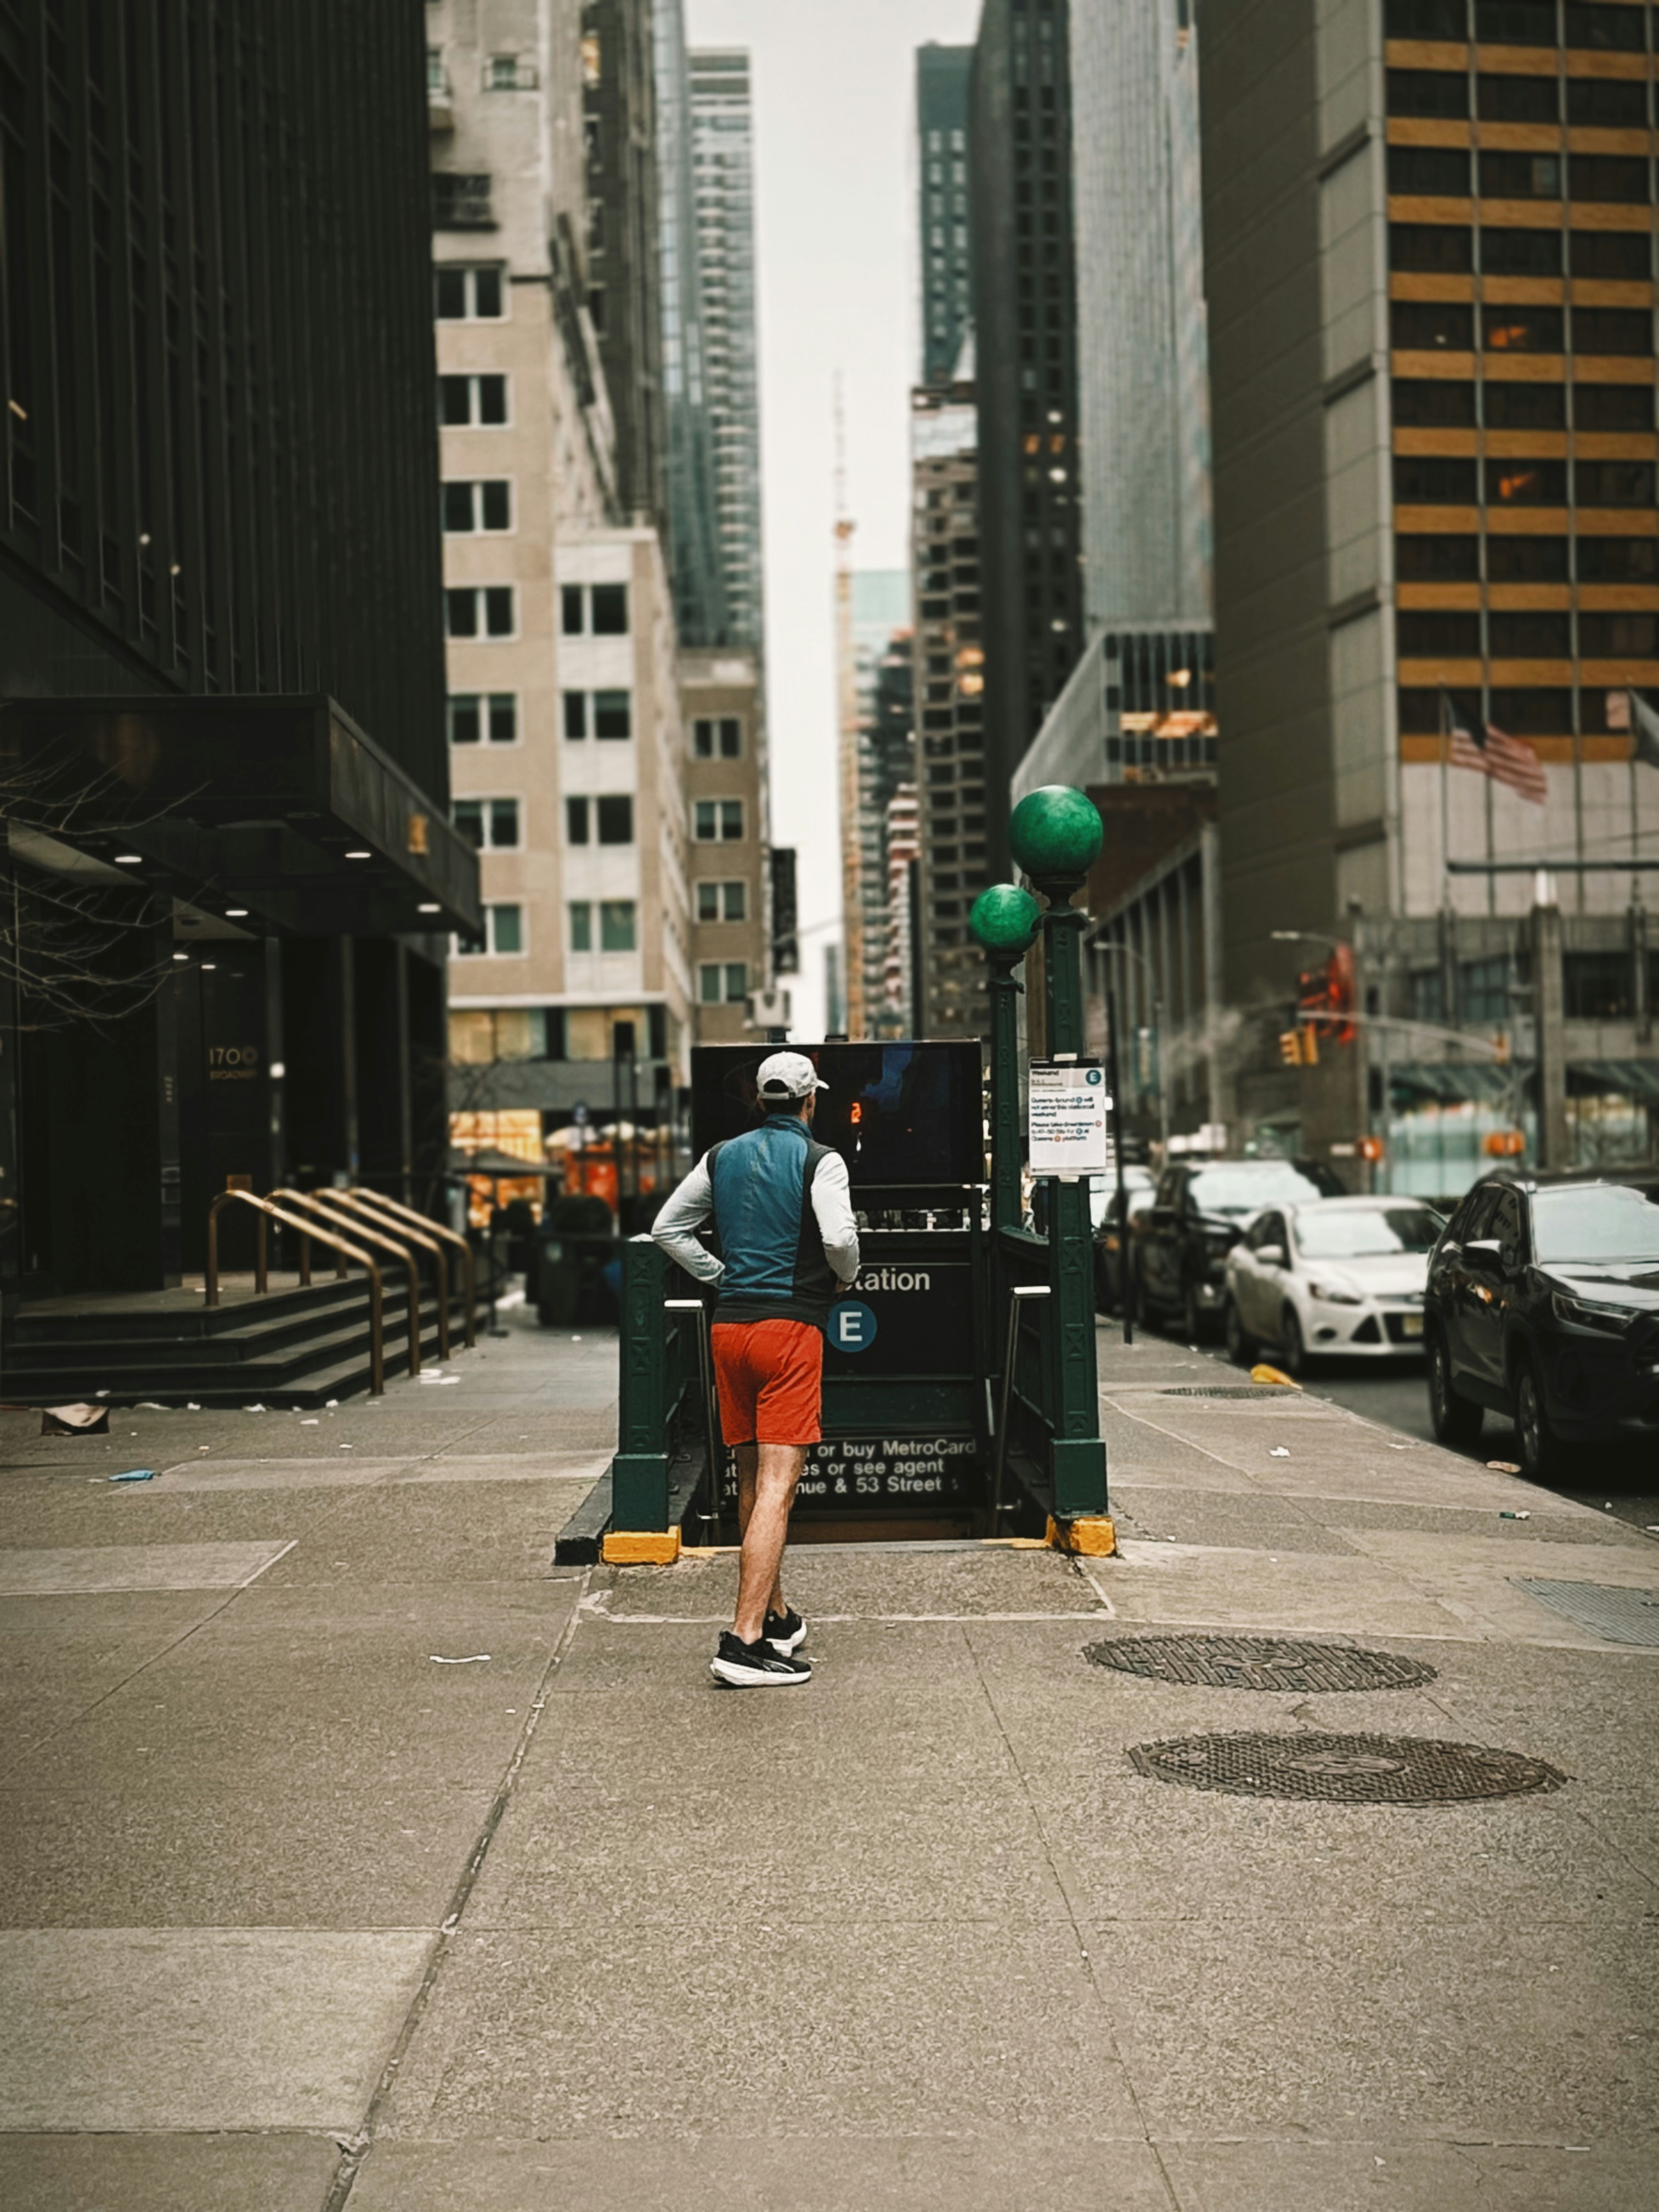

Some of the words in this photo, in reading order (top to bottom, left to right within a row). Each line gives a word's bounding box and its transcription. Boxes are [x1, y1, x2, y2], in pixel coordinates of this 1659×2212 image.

[210, 1046, 258, 1065] 1700
[1089, 1072, 1098, 1082] E
[840, 1311, 862, 1341] E
[817, 1445, 836, 1457] or
[843, 1441, 875, 1459] buy
[883, 1438, 976, 1455] MetroCard
[827, 1463, 846, 1475] or
[854, 1462, 886, 1475] see
[894, 1458, 944, 1477] agent
[834, 1477, 847, 1494] &
[856, 1476, 879, 1493] 53
[887, 1476, 942, 1492] Street
